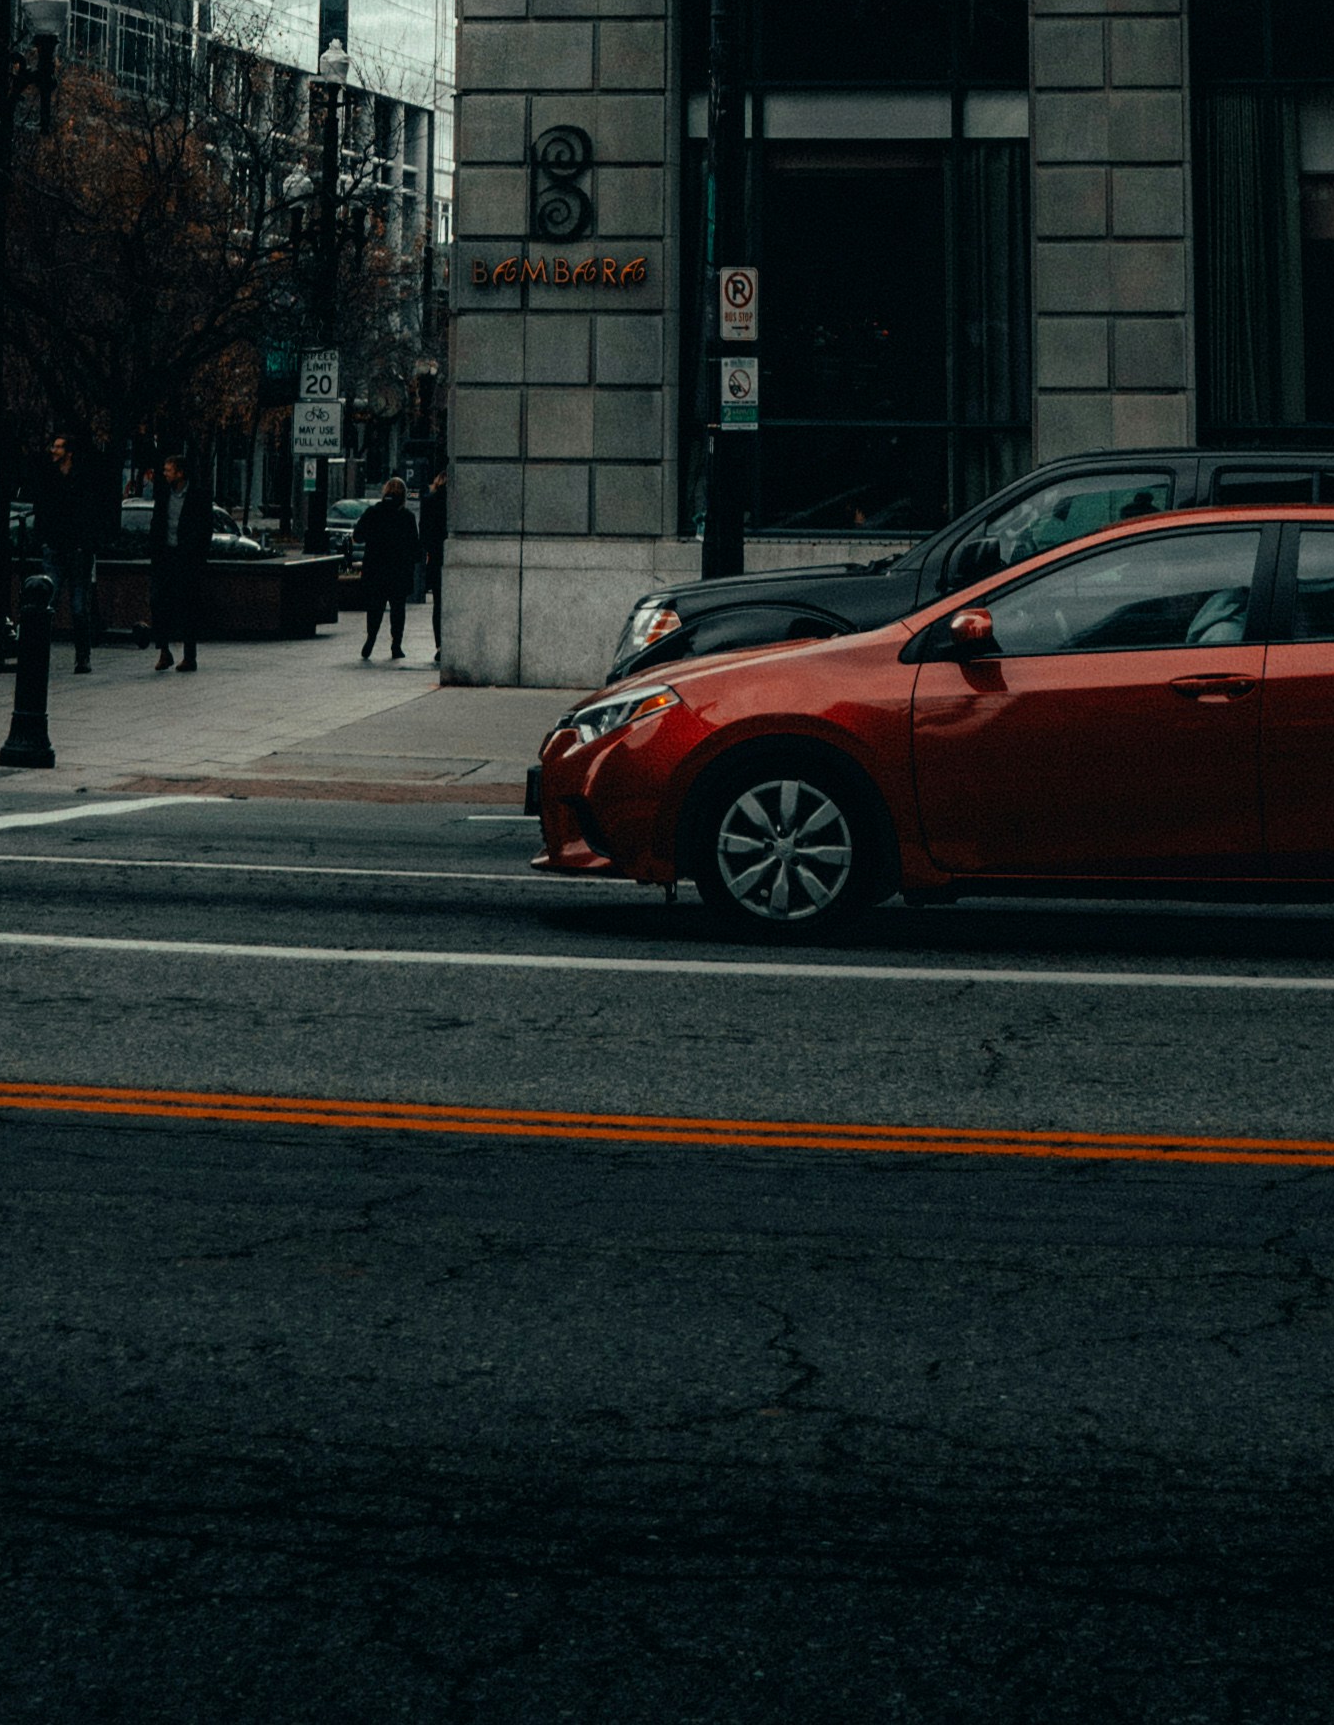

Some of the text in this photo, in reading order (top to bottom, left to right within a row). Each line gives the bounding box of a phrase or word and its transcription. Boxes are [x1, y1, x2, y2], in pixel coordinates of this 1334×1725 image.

[471, 256, 648, 286] BAMBARA
[738, 311, 753, 322] STOP
[306, 362, 332, 371] LIMIT
[305, 374, 332, 395] 20
[298, 426, 335, 434] MAY USE
[295, 438, 338, 446] FULL LANE
